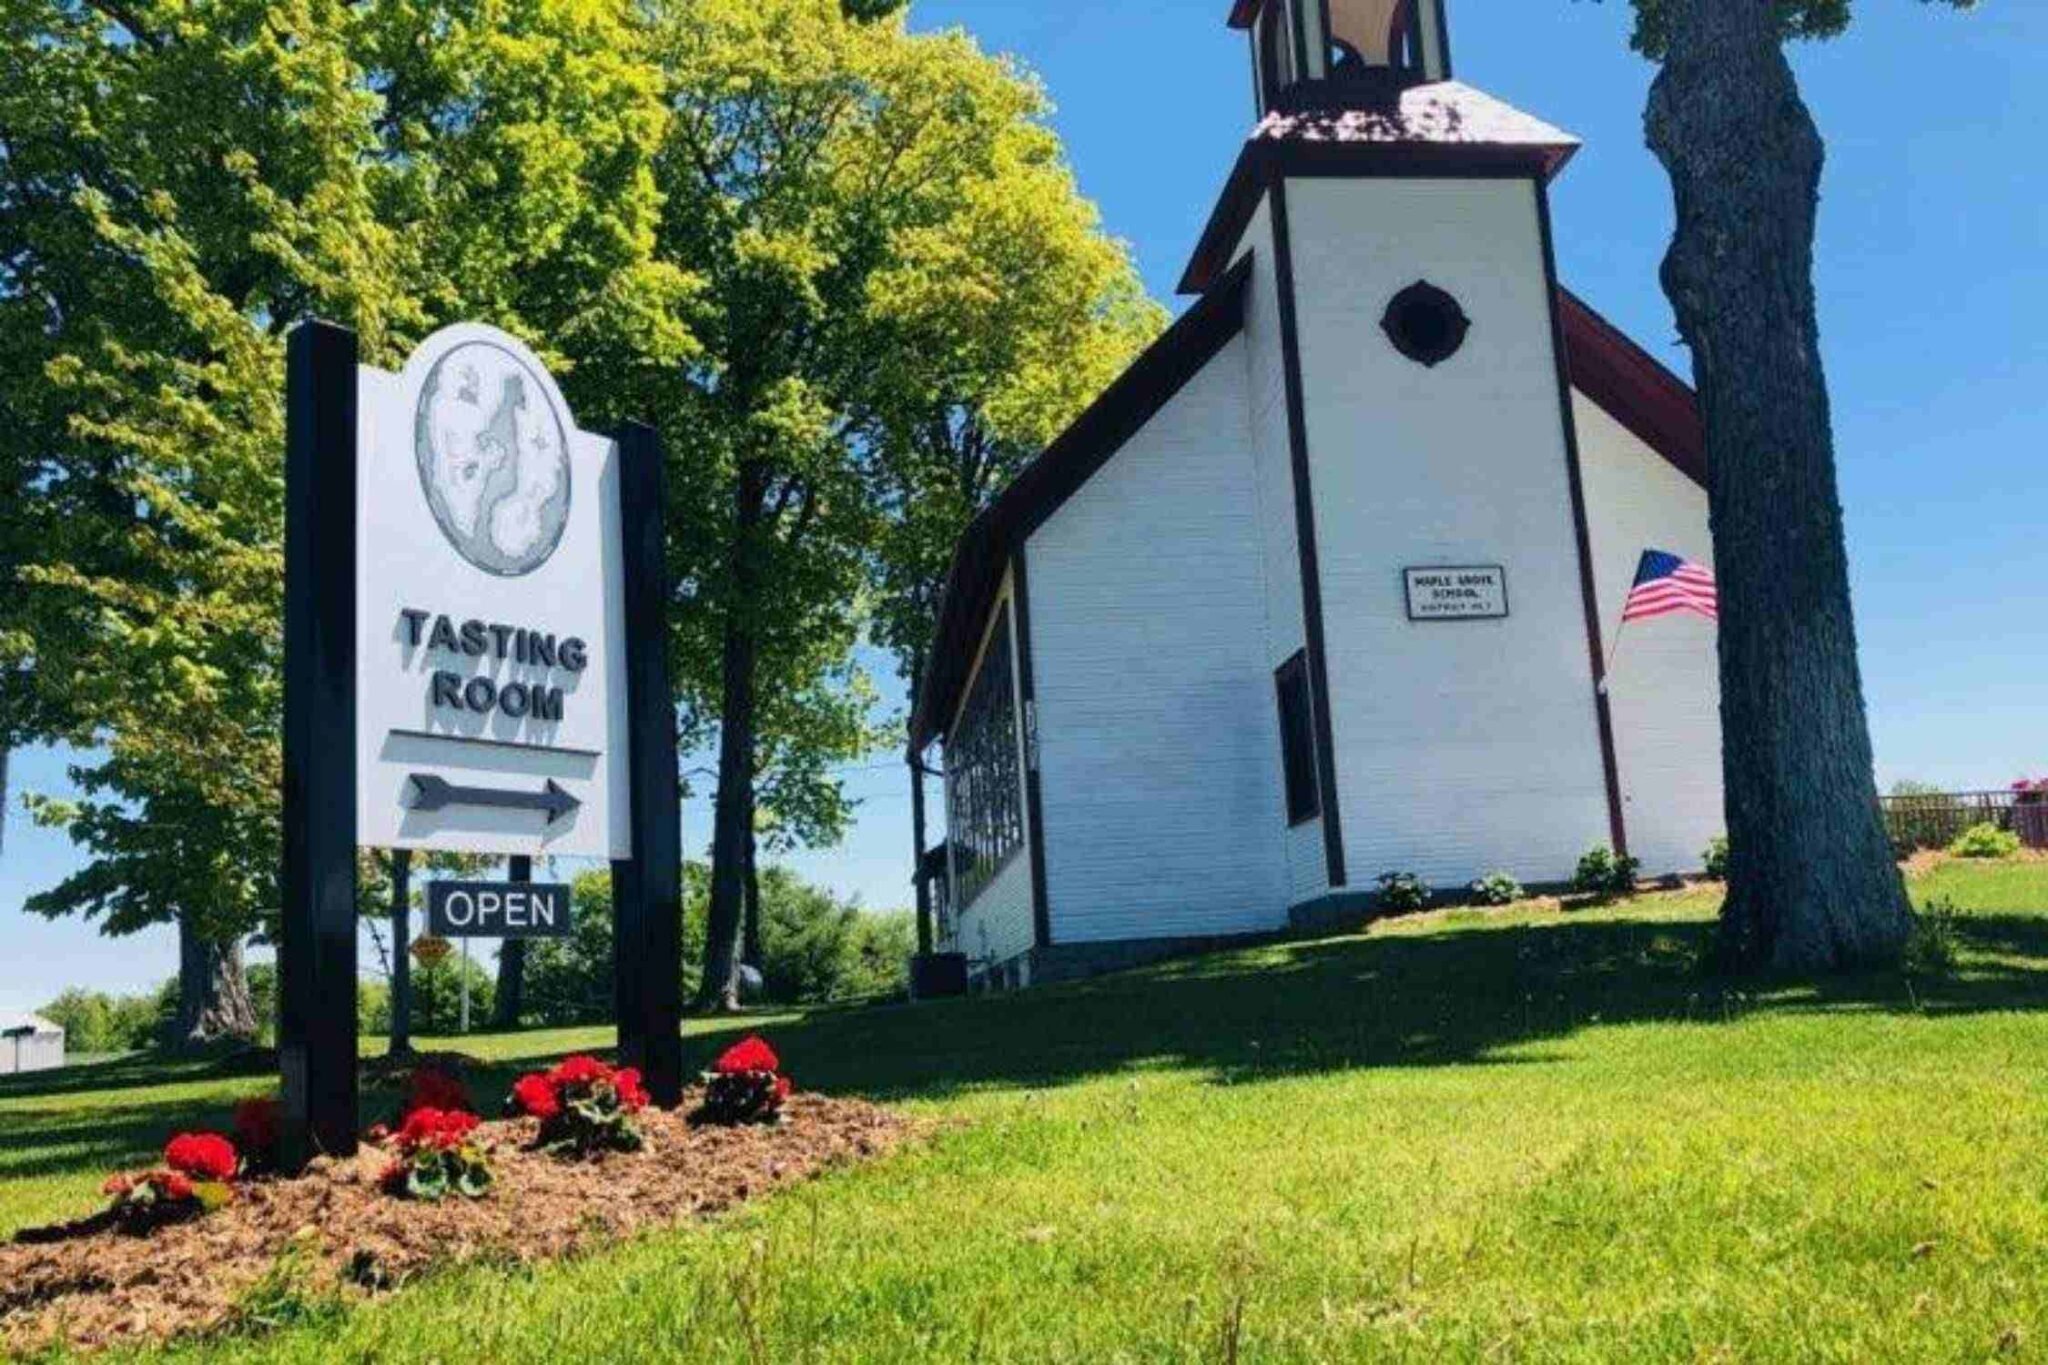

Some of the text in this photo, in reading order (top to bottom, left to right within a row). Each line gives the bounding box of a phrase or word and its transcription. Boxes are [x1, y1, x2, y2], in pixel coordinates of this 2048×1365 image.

[1414, 575, 1452, 588] MAPLE
[1432, 587, 1479, 600] SCHOOL
[401, 608, 588, 672] TASTING
[432, 670, 564, 721] ROOM
[445, 890, 555, 927] OPEN
